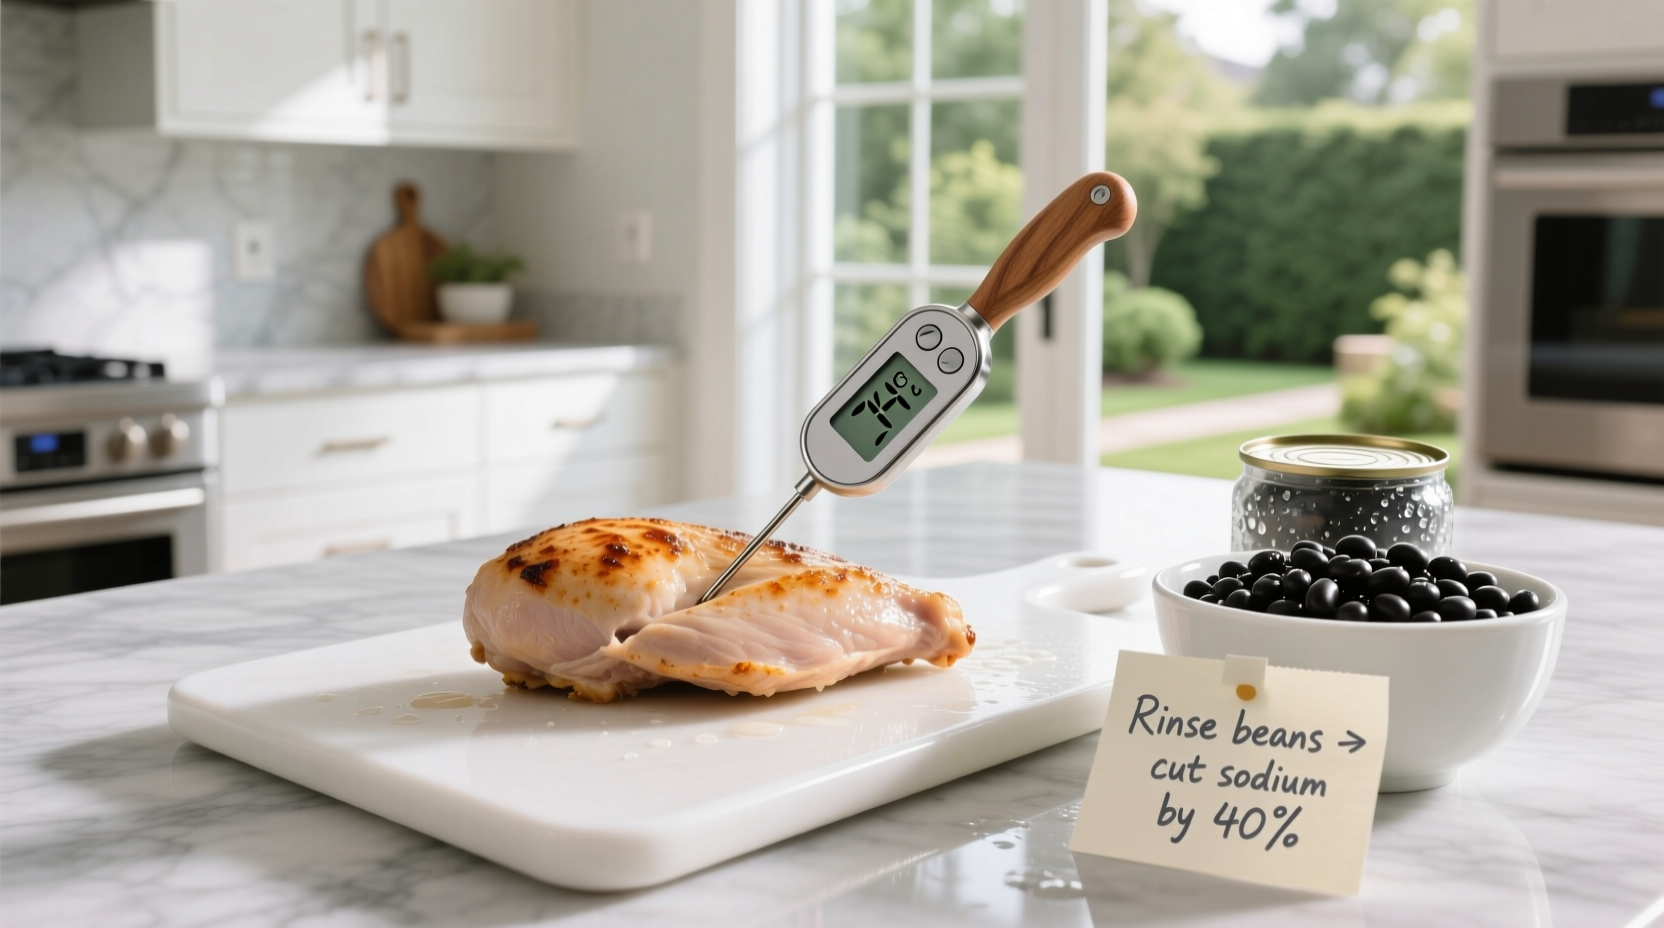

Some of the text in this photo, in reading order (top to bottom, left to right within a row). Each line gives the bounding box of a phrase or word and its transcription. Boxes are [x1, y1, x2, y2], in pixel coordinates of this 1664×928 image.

[1128, 693, 1324, 753] Rinse beans
[1150, 754, 1327, 797] cut sodium
[1156, 791, 1303, 852] by 40%
